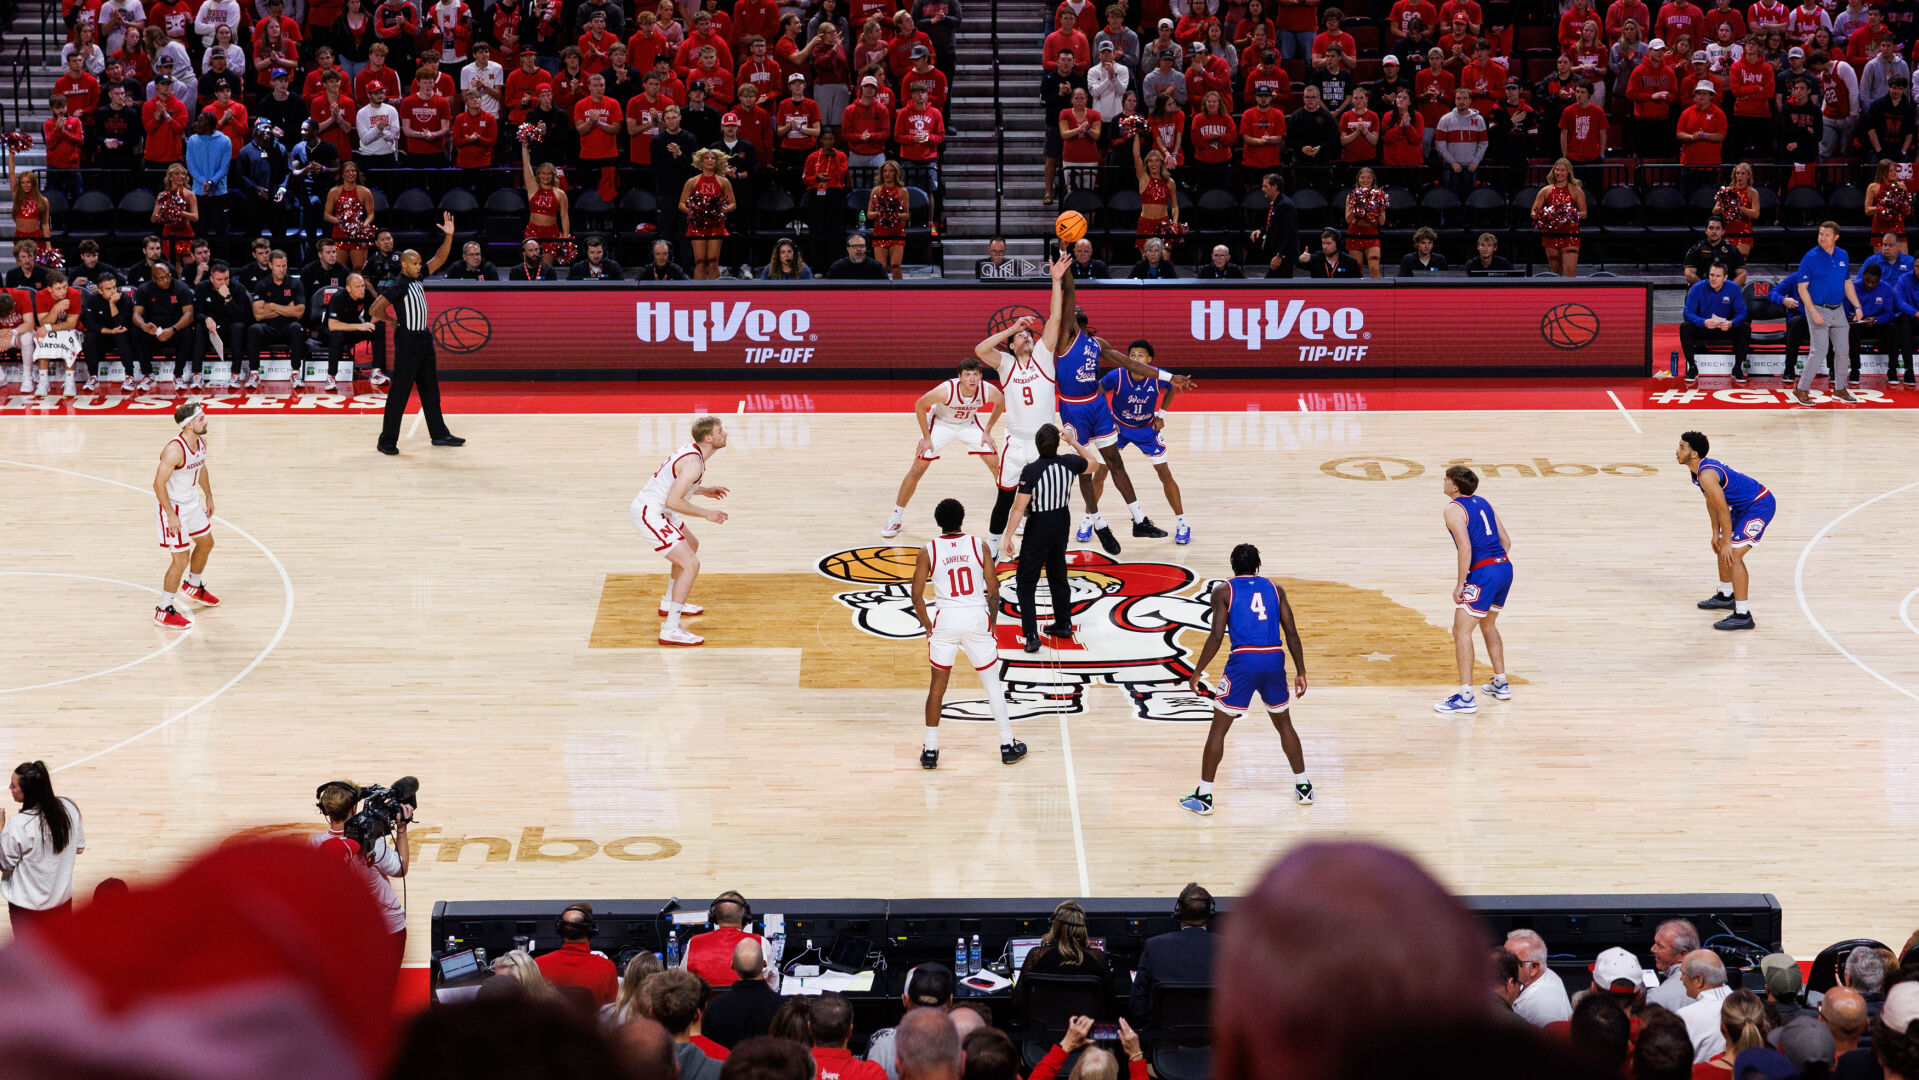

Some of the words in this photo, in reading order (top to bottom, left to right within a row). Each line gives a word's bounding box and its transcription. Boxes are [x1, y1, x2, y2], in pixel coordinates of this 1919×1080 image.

[700, 183, 716, 195] N
[1753, 281, 1770, 297] N
[744, 347, 817, 363] TIP-OFF
[1298, 345, 1369, 361] TIP-OFF
[0, 394, 388, 410] HUSKERS
[1022, 386, 1034, 406] 9
[1649, 388, 1895, 404] #GBR
[953, 411, 971, 420] 21
[1133, 404, 1143, 415] 11
[1479, 509, 1493, 536] 1
[660, 524, 674, 538] N
[943, 554, 971, 567] LAWRENCE
[947, 565, 975, 599] 10
[1250, 591, 1269, 622] 4
[405, 826, 683, 863] fnbo
